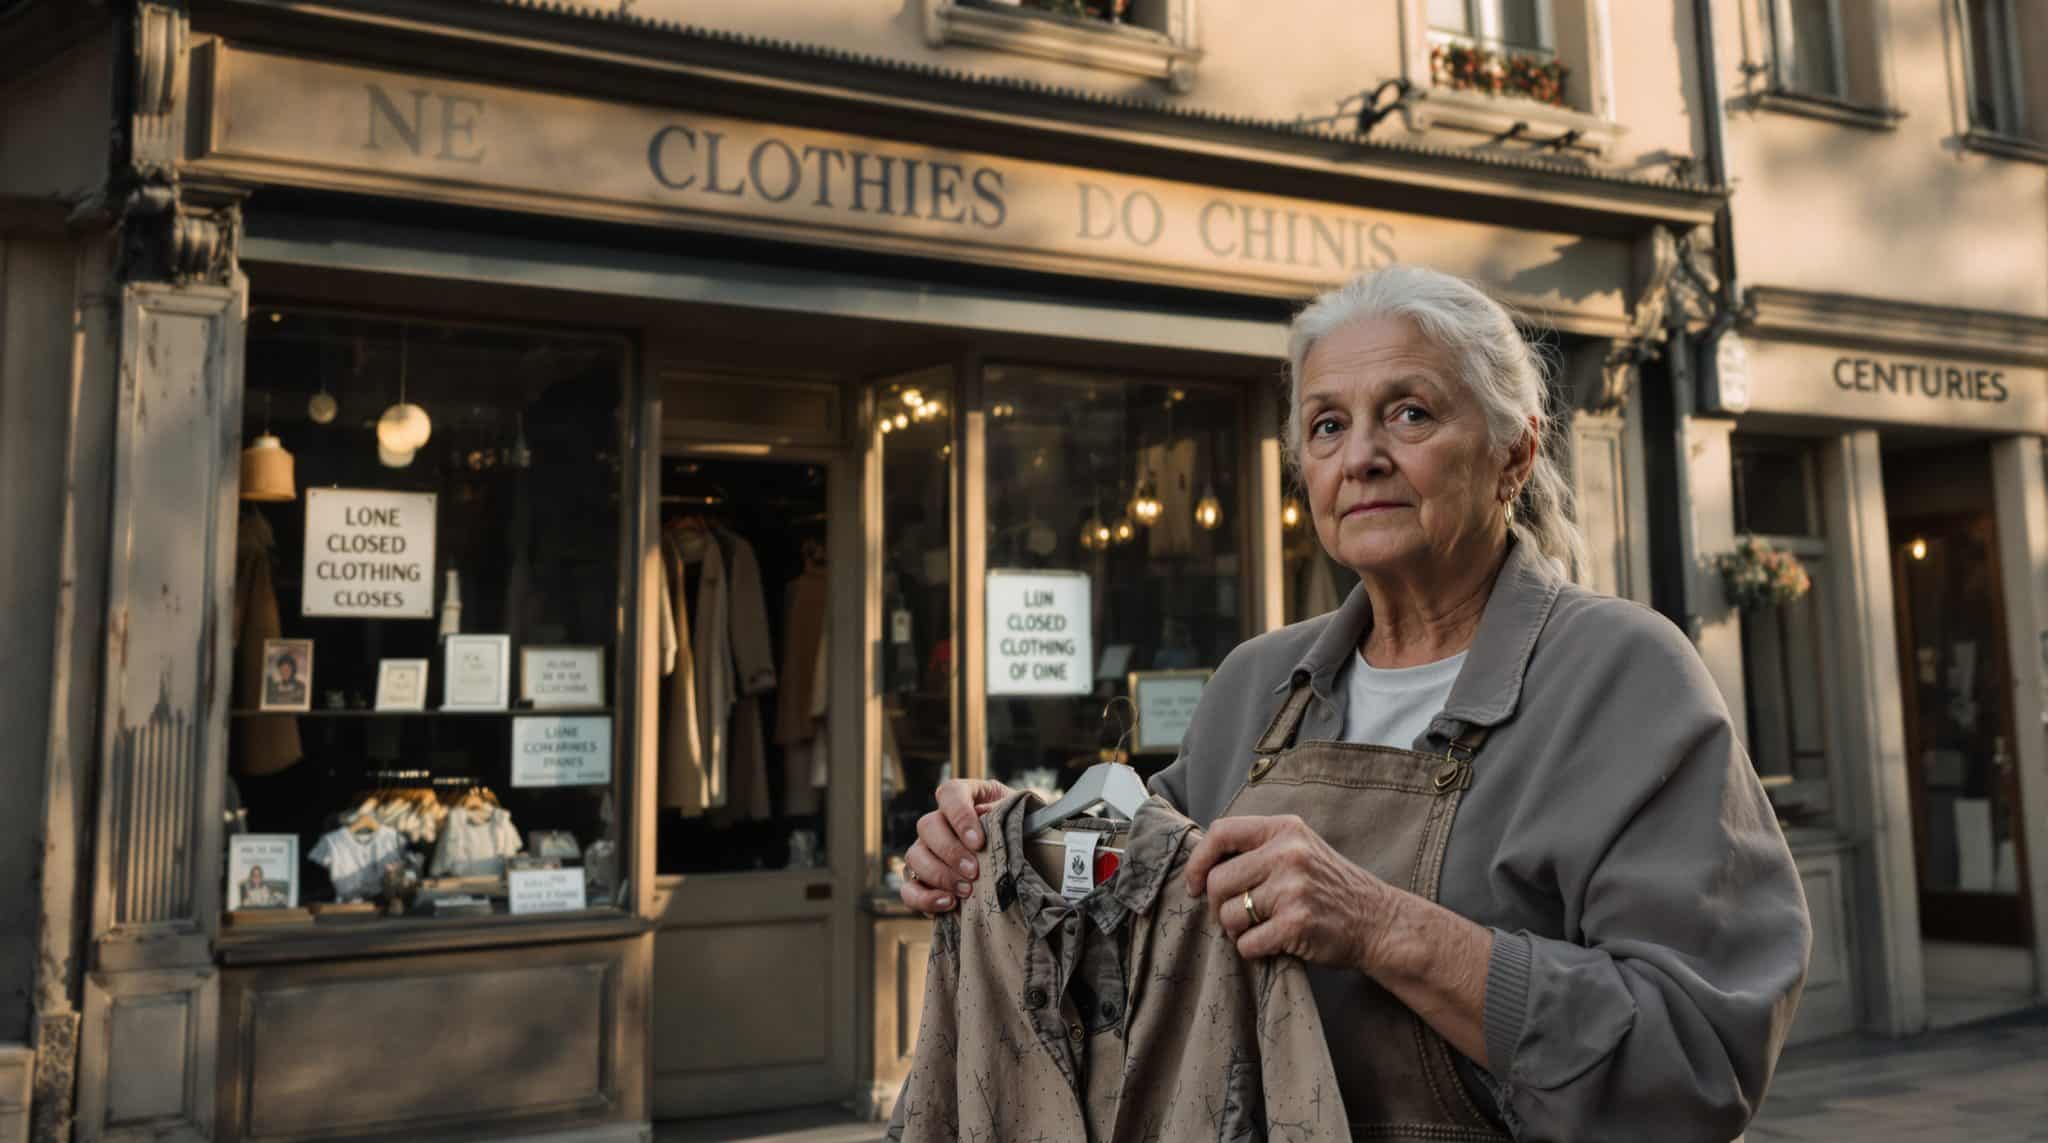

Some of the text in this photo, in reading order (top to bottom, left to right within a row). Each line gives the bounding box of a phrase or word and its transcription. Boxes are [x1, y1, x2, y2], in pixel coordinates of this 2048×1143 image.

[647, 124, 1007, 229] CLOTHIES
[1075, 181, 1165, 247] DO
[1200, 198, 1399, 273] CHINIS
[1833, 357, 2009, 402] CENTURIES
[345, 506, 401, 528] LONE
[327, 533, 406, 554] CLOSED
[316, 561, 421, 582] CLOTHING
[333, 590, 405, 608] CLOSES
[1007, 613, 1067, 632] CLOSED
[1000, 638, 1076, 656] CLOTHING
